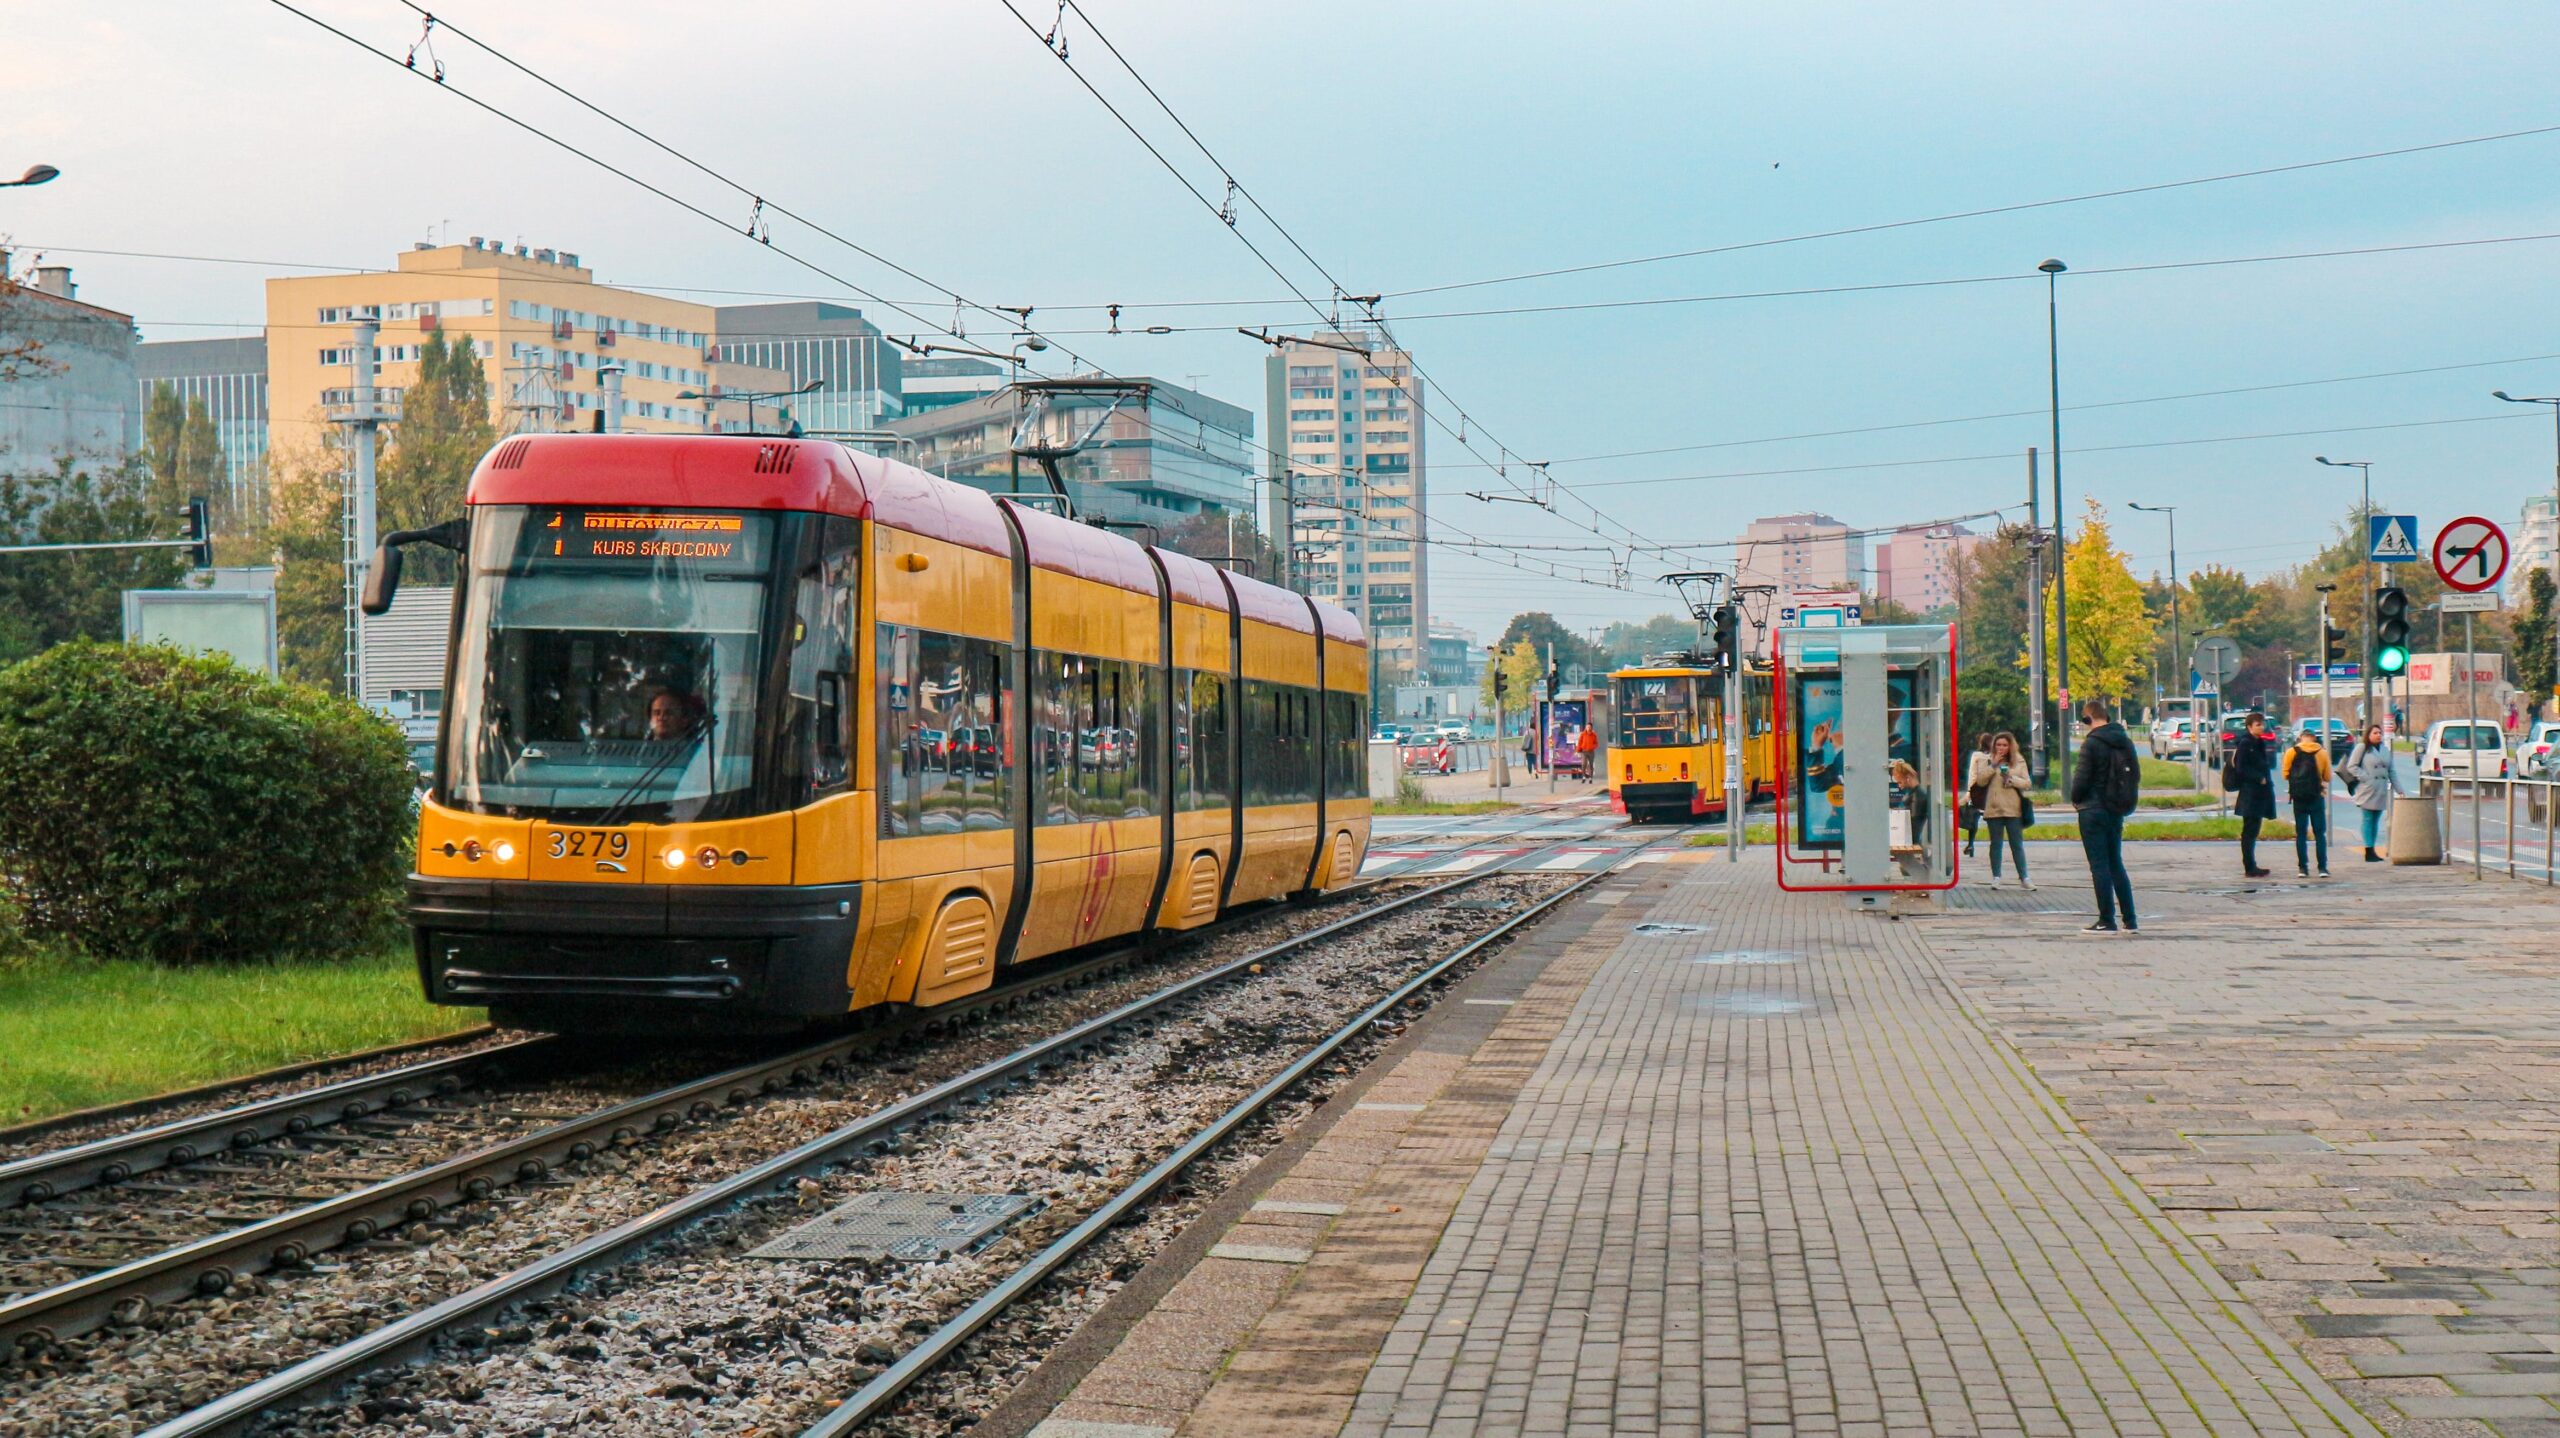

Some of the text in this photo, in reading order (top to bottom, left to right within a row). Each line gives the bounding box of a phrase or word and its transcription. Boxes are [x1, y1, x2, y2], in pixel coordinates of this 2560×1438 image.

[592, 540, 732, 557] KURS SKROCONY
[2318, 667, 2346, 675] PKING
[1647, 681, 1664, 696] 22
[547, 831, 630, 859] 3279
